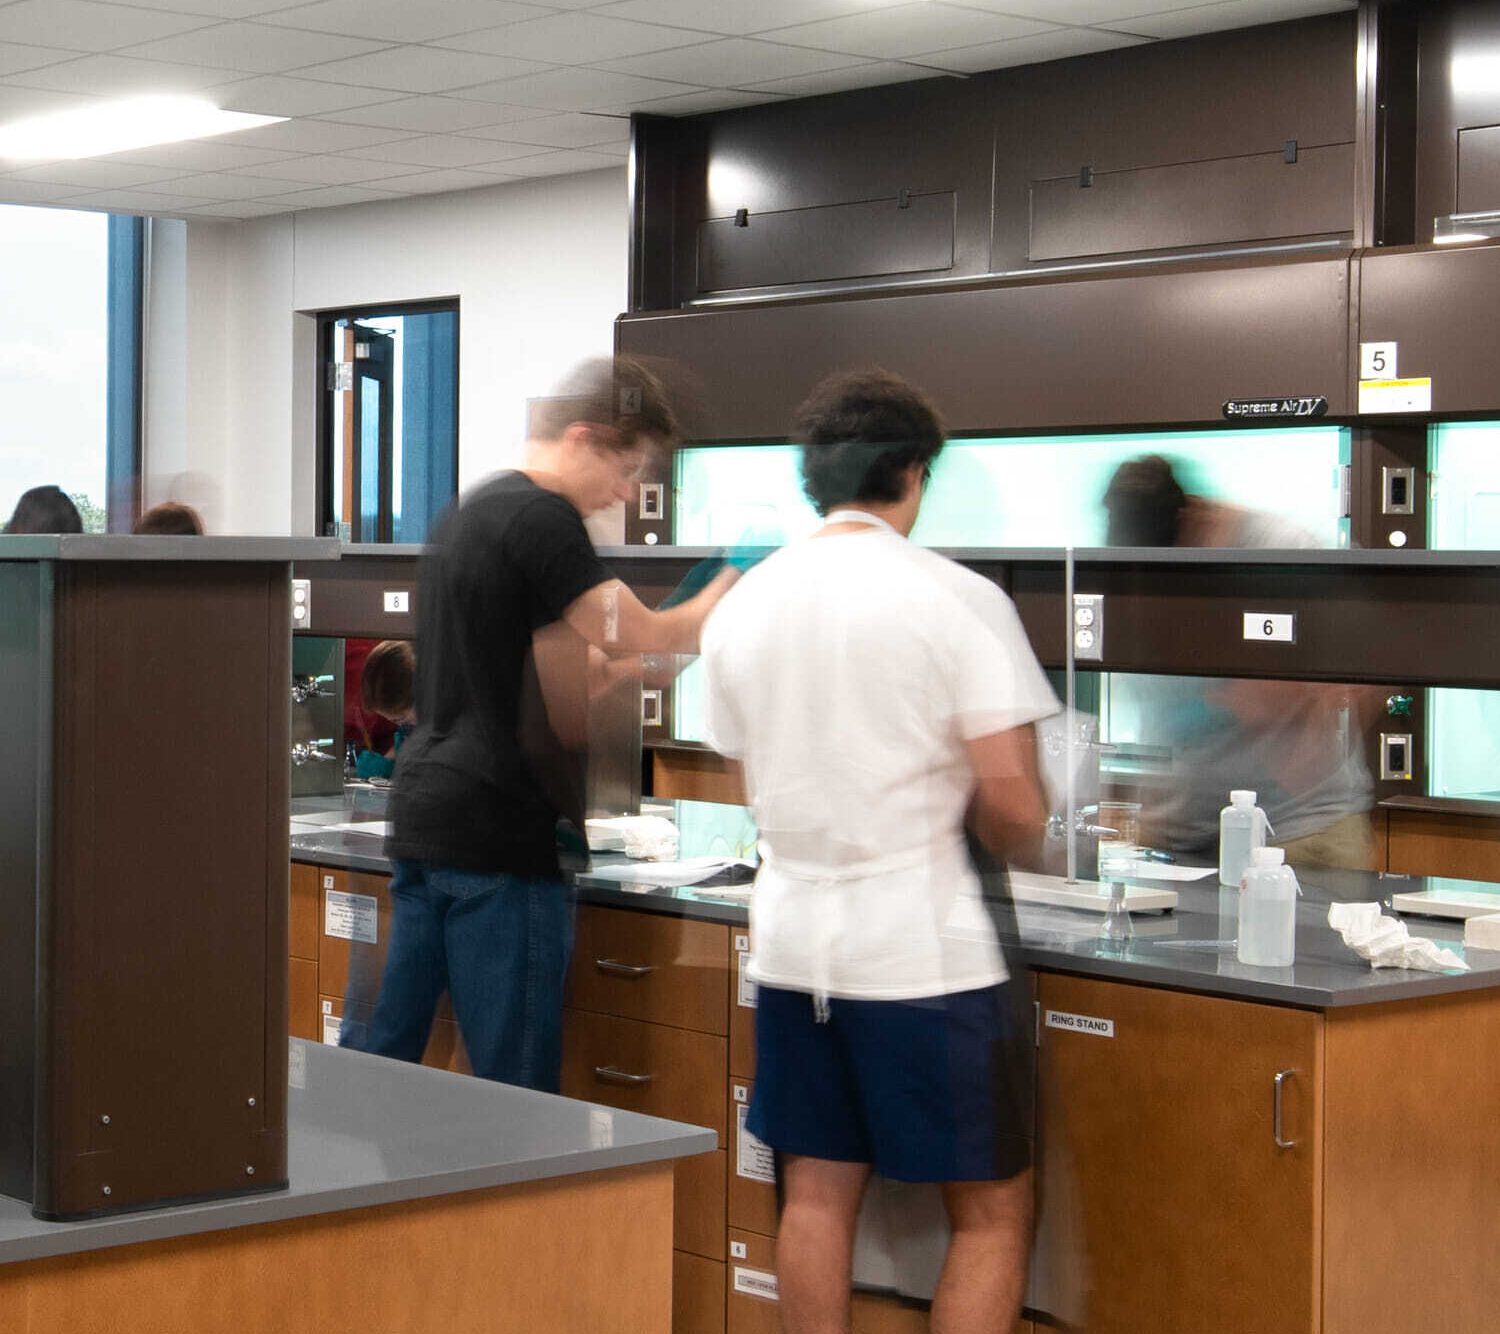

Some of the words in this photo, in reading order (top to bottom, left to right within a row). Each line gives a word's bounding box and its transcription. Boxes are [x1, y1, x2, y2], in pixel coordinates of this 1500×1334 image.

[1372, 350, 1386, 372] 5
[1227, 402, 1278, 416] Supreme
[1280, 400, 1298, 413] Air
[393, 595, 400, 609] 8
[1263, 619, 1274, 636] 6
[1051, 1013, 1074, 1027] RING
[1076, 1018, 1109, 1032] STAND
